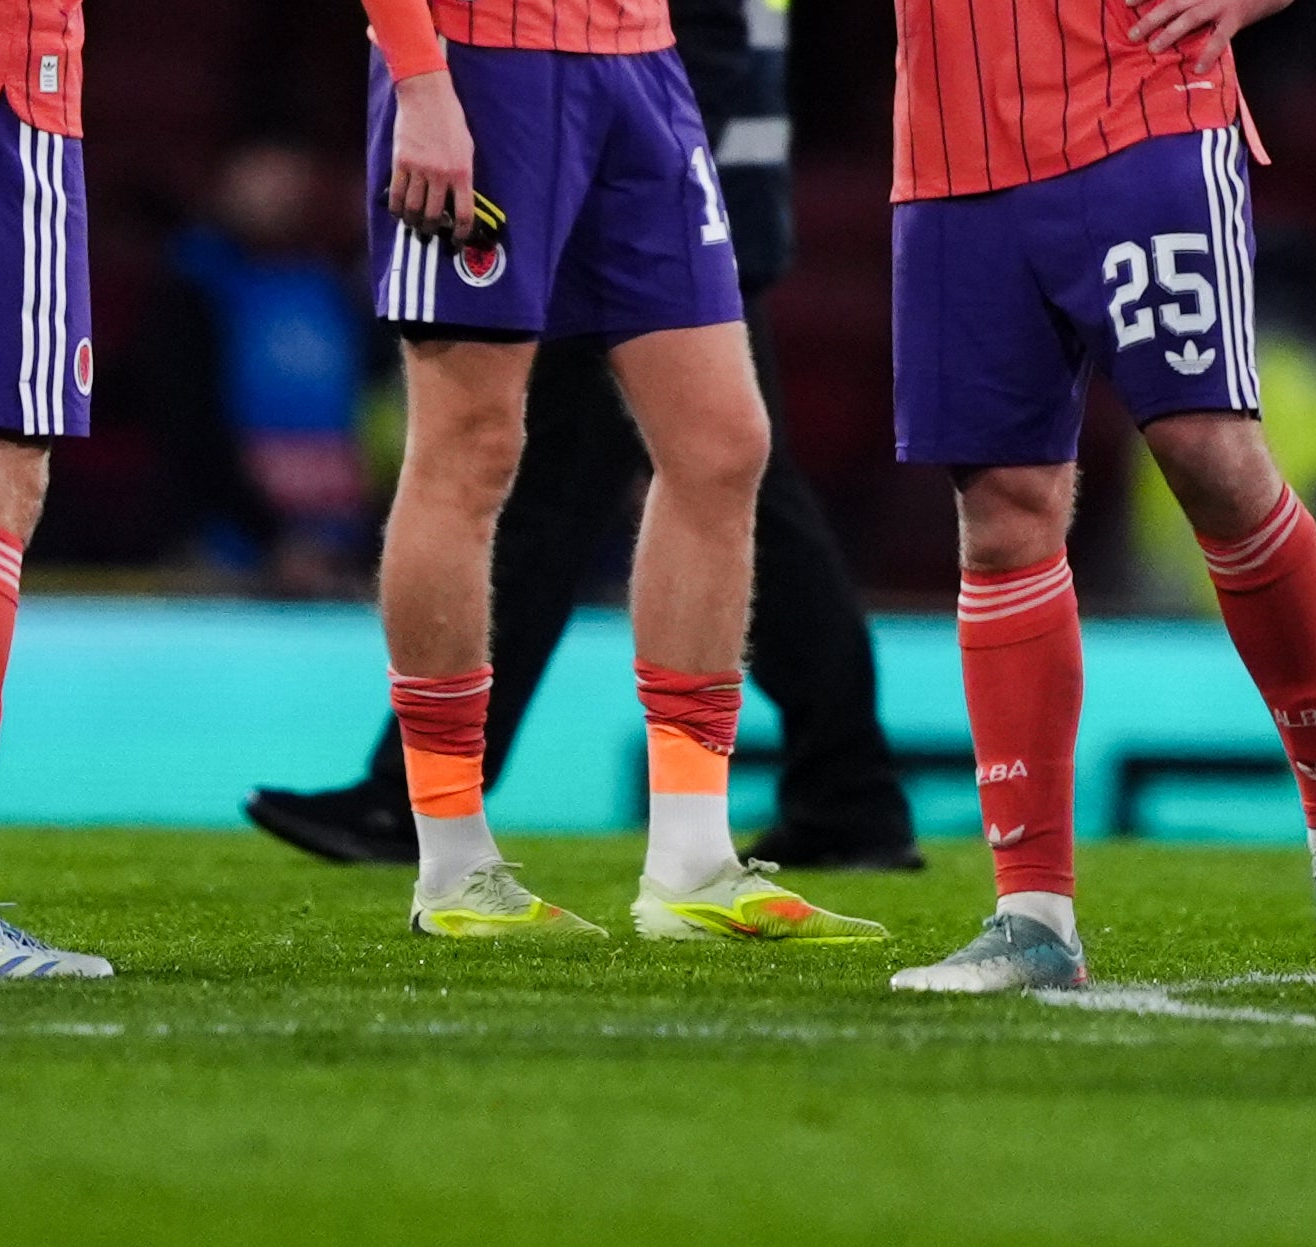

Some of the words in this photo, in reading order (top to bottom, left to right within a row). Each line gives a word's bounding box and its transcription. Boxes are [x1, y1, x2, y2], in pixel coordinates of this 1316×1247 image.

[690, 145, 731, 246] 1
[1102, 232, 1217, 352] 25
[975, 759, 1029, 787] LBA
